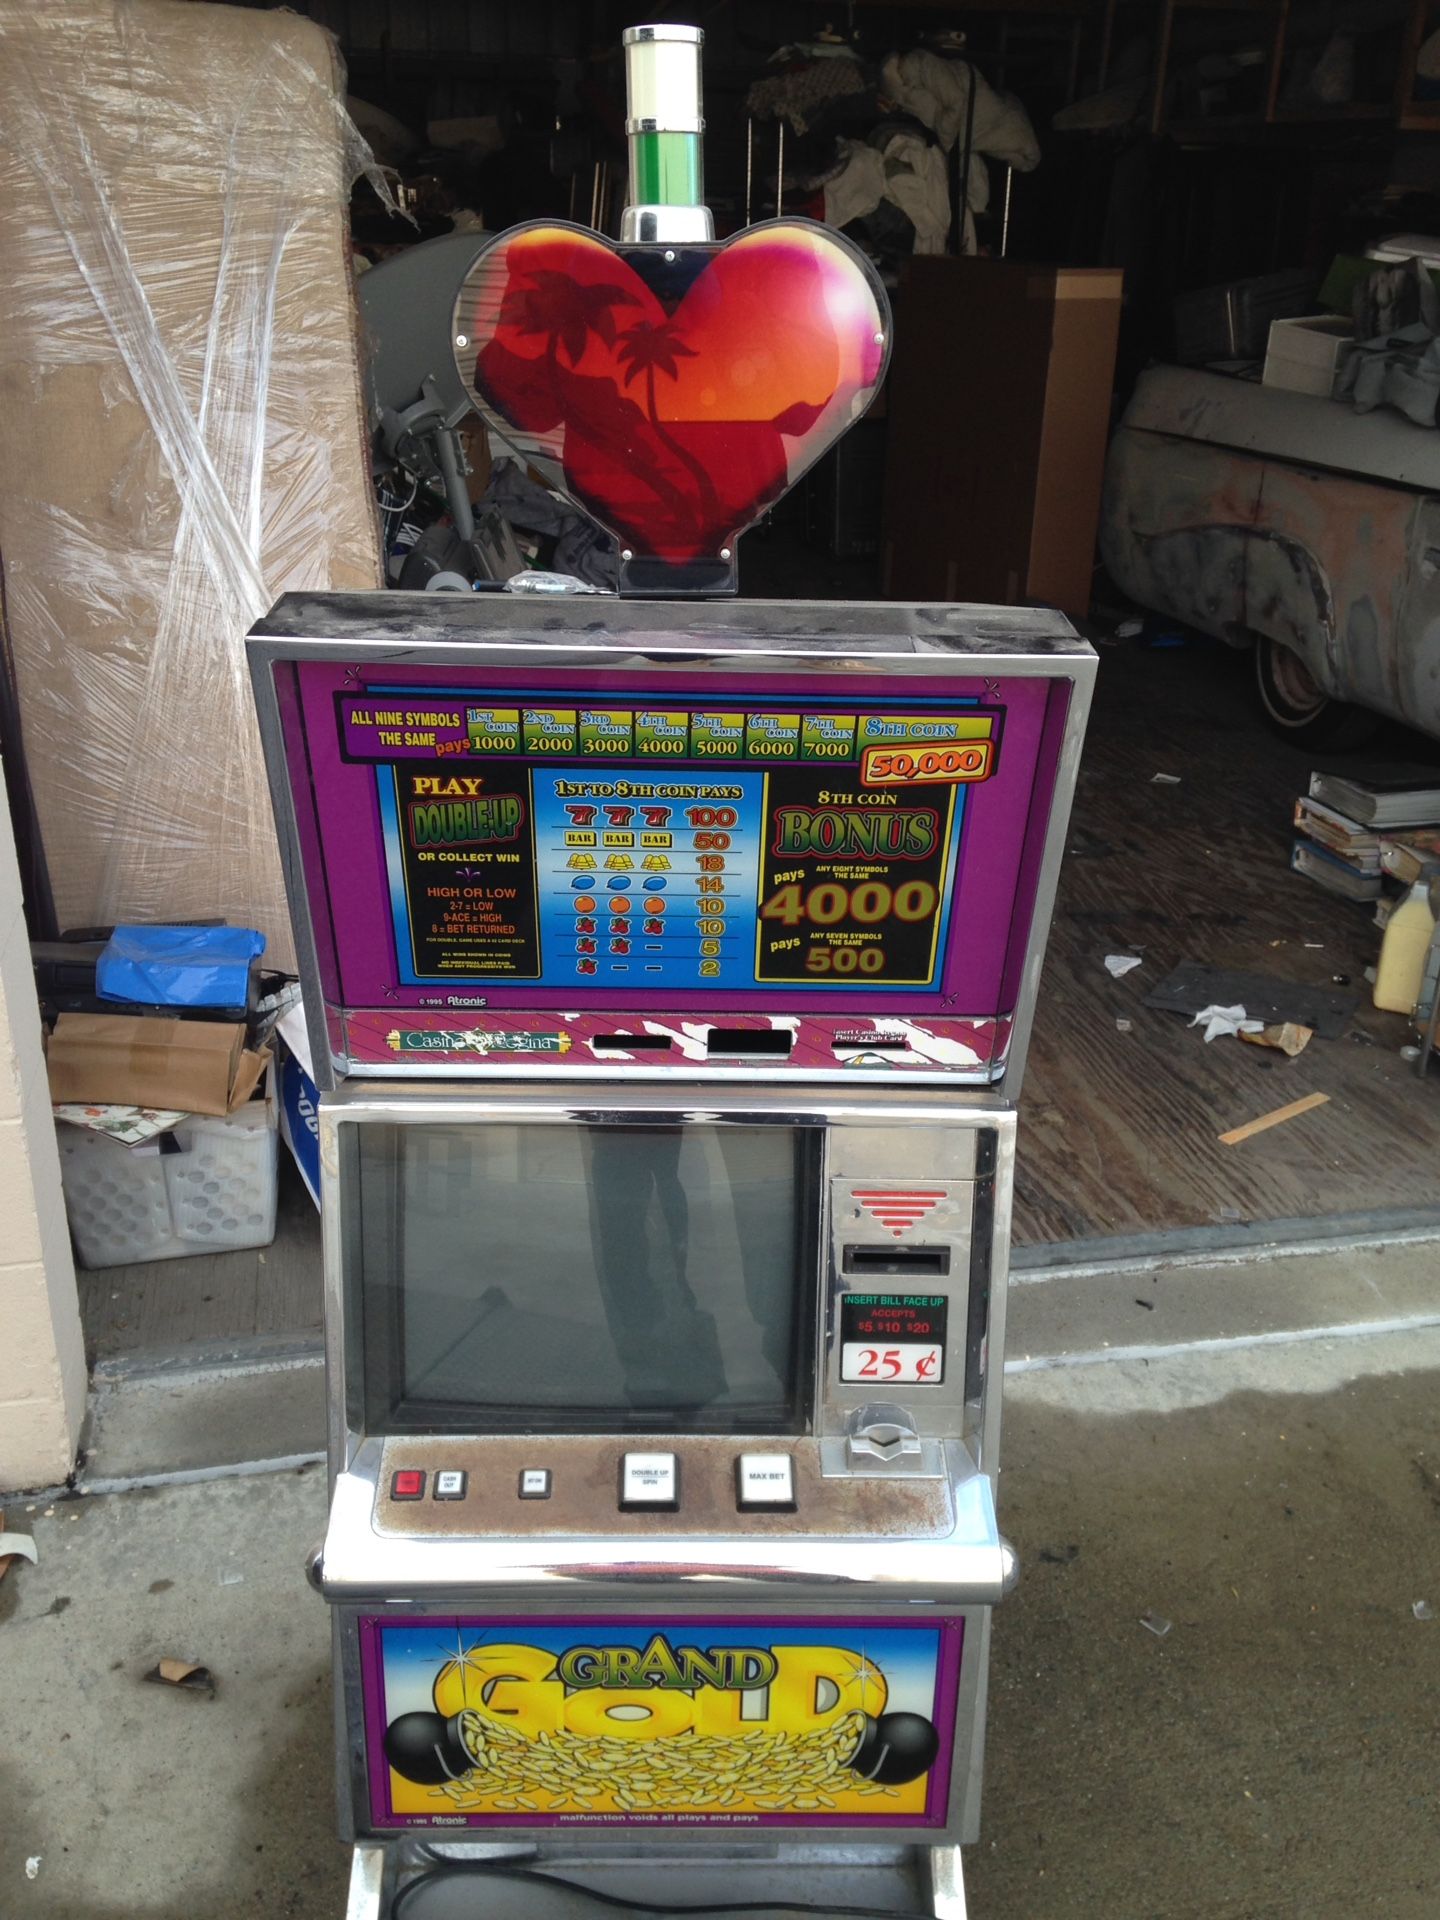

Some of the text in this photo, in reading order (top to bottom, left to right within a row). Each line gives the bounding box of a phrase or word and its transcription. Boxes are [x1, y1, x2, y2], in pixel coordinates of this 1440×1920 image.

[351, 711, 461, 727] ALL NINE SYMBOLS
[467, 709, 494, 723] 1ST
[523, 710, 555, 724] 2ND
[580, 711, 611, 726] 3RD
[635, 711, 667, 727] 4TH
[692, 713, 721, 728] 5TH
[748, 714, 777, 729] 6TH
[804, 716, 835, 730] 7TH
[485, 722, 519, 733] COIN
[541, 723, 576, 734] COIN
[597, 724, 631, 735] COIN
[653, 725, 687, 736] COIN
[710, 726, 743, 738] COIN
[766, 728, 799, 739] COIN
[821, 729, 854, 739] COIN
[865, 716, 958, 738] 8TH COIN
[378, 732, 471, 756] THE SAME pays
[473, 736, 516, 749] 1000
[528, 737, 573, 751] 2000
[584, 738, 629, 752] 3000
[638, 739, 684, 753] 4000
[696, 740, 738, 755] 5000
[748, 740, 794, 756] 6000
[805, 742, 849, 756] 7000
[869, 750, 982, 779] 50,000
[413, 777, 482, 796] PLAY
[555, 780, 743, 799] 1ST TO 8TH COIN PAYS
[818, 791, 897, 805] 8TH COIN
[686, 805, 738, 828] 100
[567, 831, 730, 850] BAR BAR BAR 50
[777, 810, 934, 857] BONUS
[418, 852, 520, 863] OR COLLECT WIN
[696, 854, 725, 872] 18
[774, 869, 805, 885] pays
[427, 887, 516, 898] HIGH OR LOW
[696, 876, 724, 894] 14
[449, 901, 463, 910] 2-7
[473, 902, 494, 911] LOW
[696, 898, 725, 915] 10
[761, 880, 937, 926] 4000
[443, 913, 470, 922] 9-ACE
[480, 913, 502, 922] HIGH
[447, 924, 465, 933] BET
[467, 924, 515, 934] RETURNED
[696, 919, 725, 936] 10
[701, 939, 721, 957] 5
[770, 937, 801, 952] pays
[806, 947, 885, 973] 500
[700, 960, 720, 977] 2
[447, 996, 487, 1006] Atronic
[880, 1296, 901, 1305] BILL
[903, 1297, 928, 1306] FACE
[930, 1298, 944, 1306] UP
[871, 1309, 916, 1318] ACCEPTS
[858, 1349, 902, 1379] 25
[558, 1634, 777, 1690] GRAND
[432, 1816, 467, 1825] Atronic
[677, 1814, 706, 1822] plays
